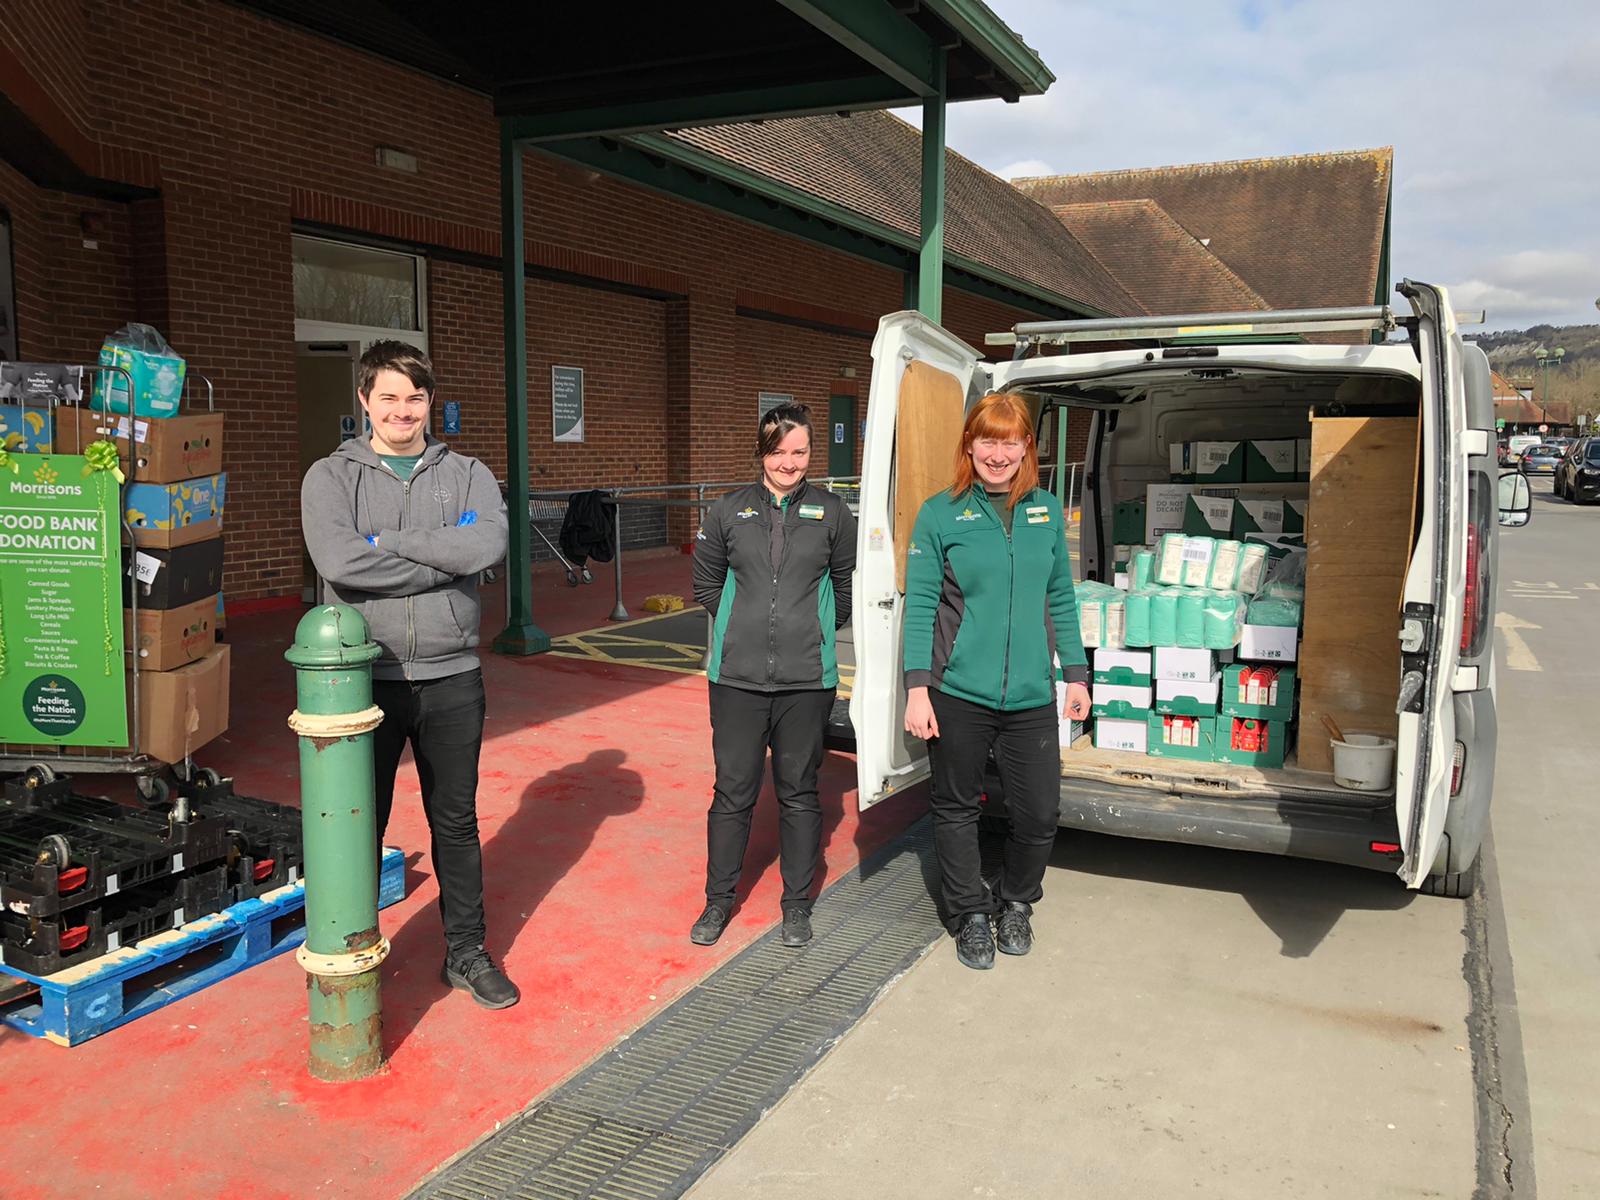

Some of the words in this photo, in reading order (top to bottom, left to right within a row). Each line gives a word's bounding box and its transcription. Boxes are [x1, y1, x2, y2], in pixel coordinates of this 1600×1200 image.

[10, 480, 82, 496] Morrisons
[192, 487, 210, 505] One
[50, 516, 98, 532] BANK
[0, 533, 96, 551] DONATION
[25, 604, 48, 612] Sanitary
[30, 613, 45, 621] Long
[37, 696, 70, 707] Feeding
[32, 705, 46, 713] the
[47, 705, 76, 714] Nation
